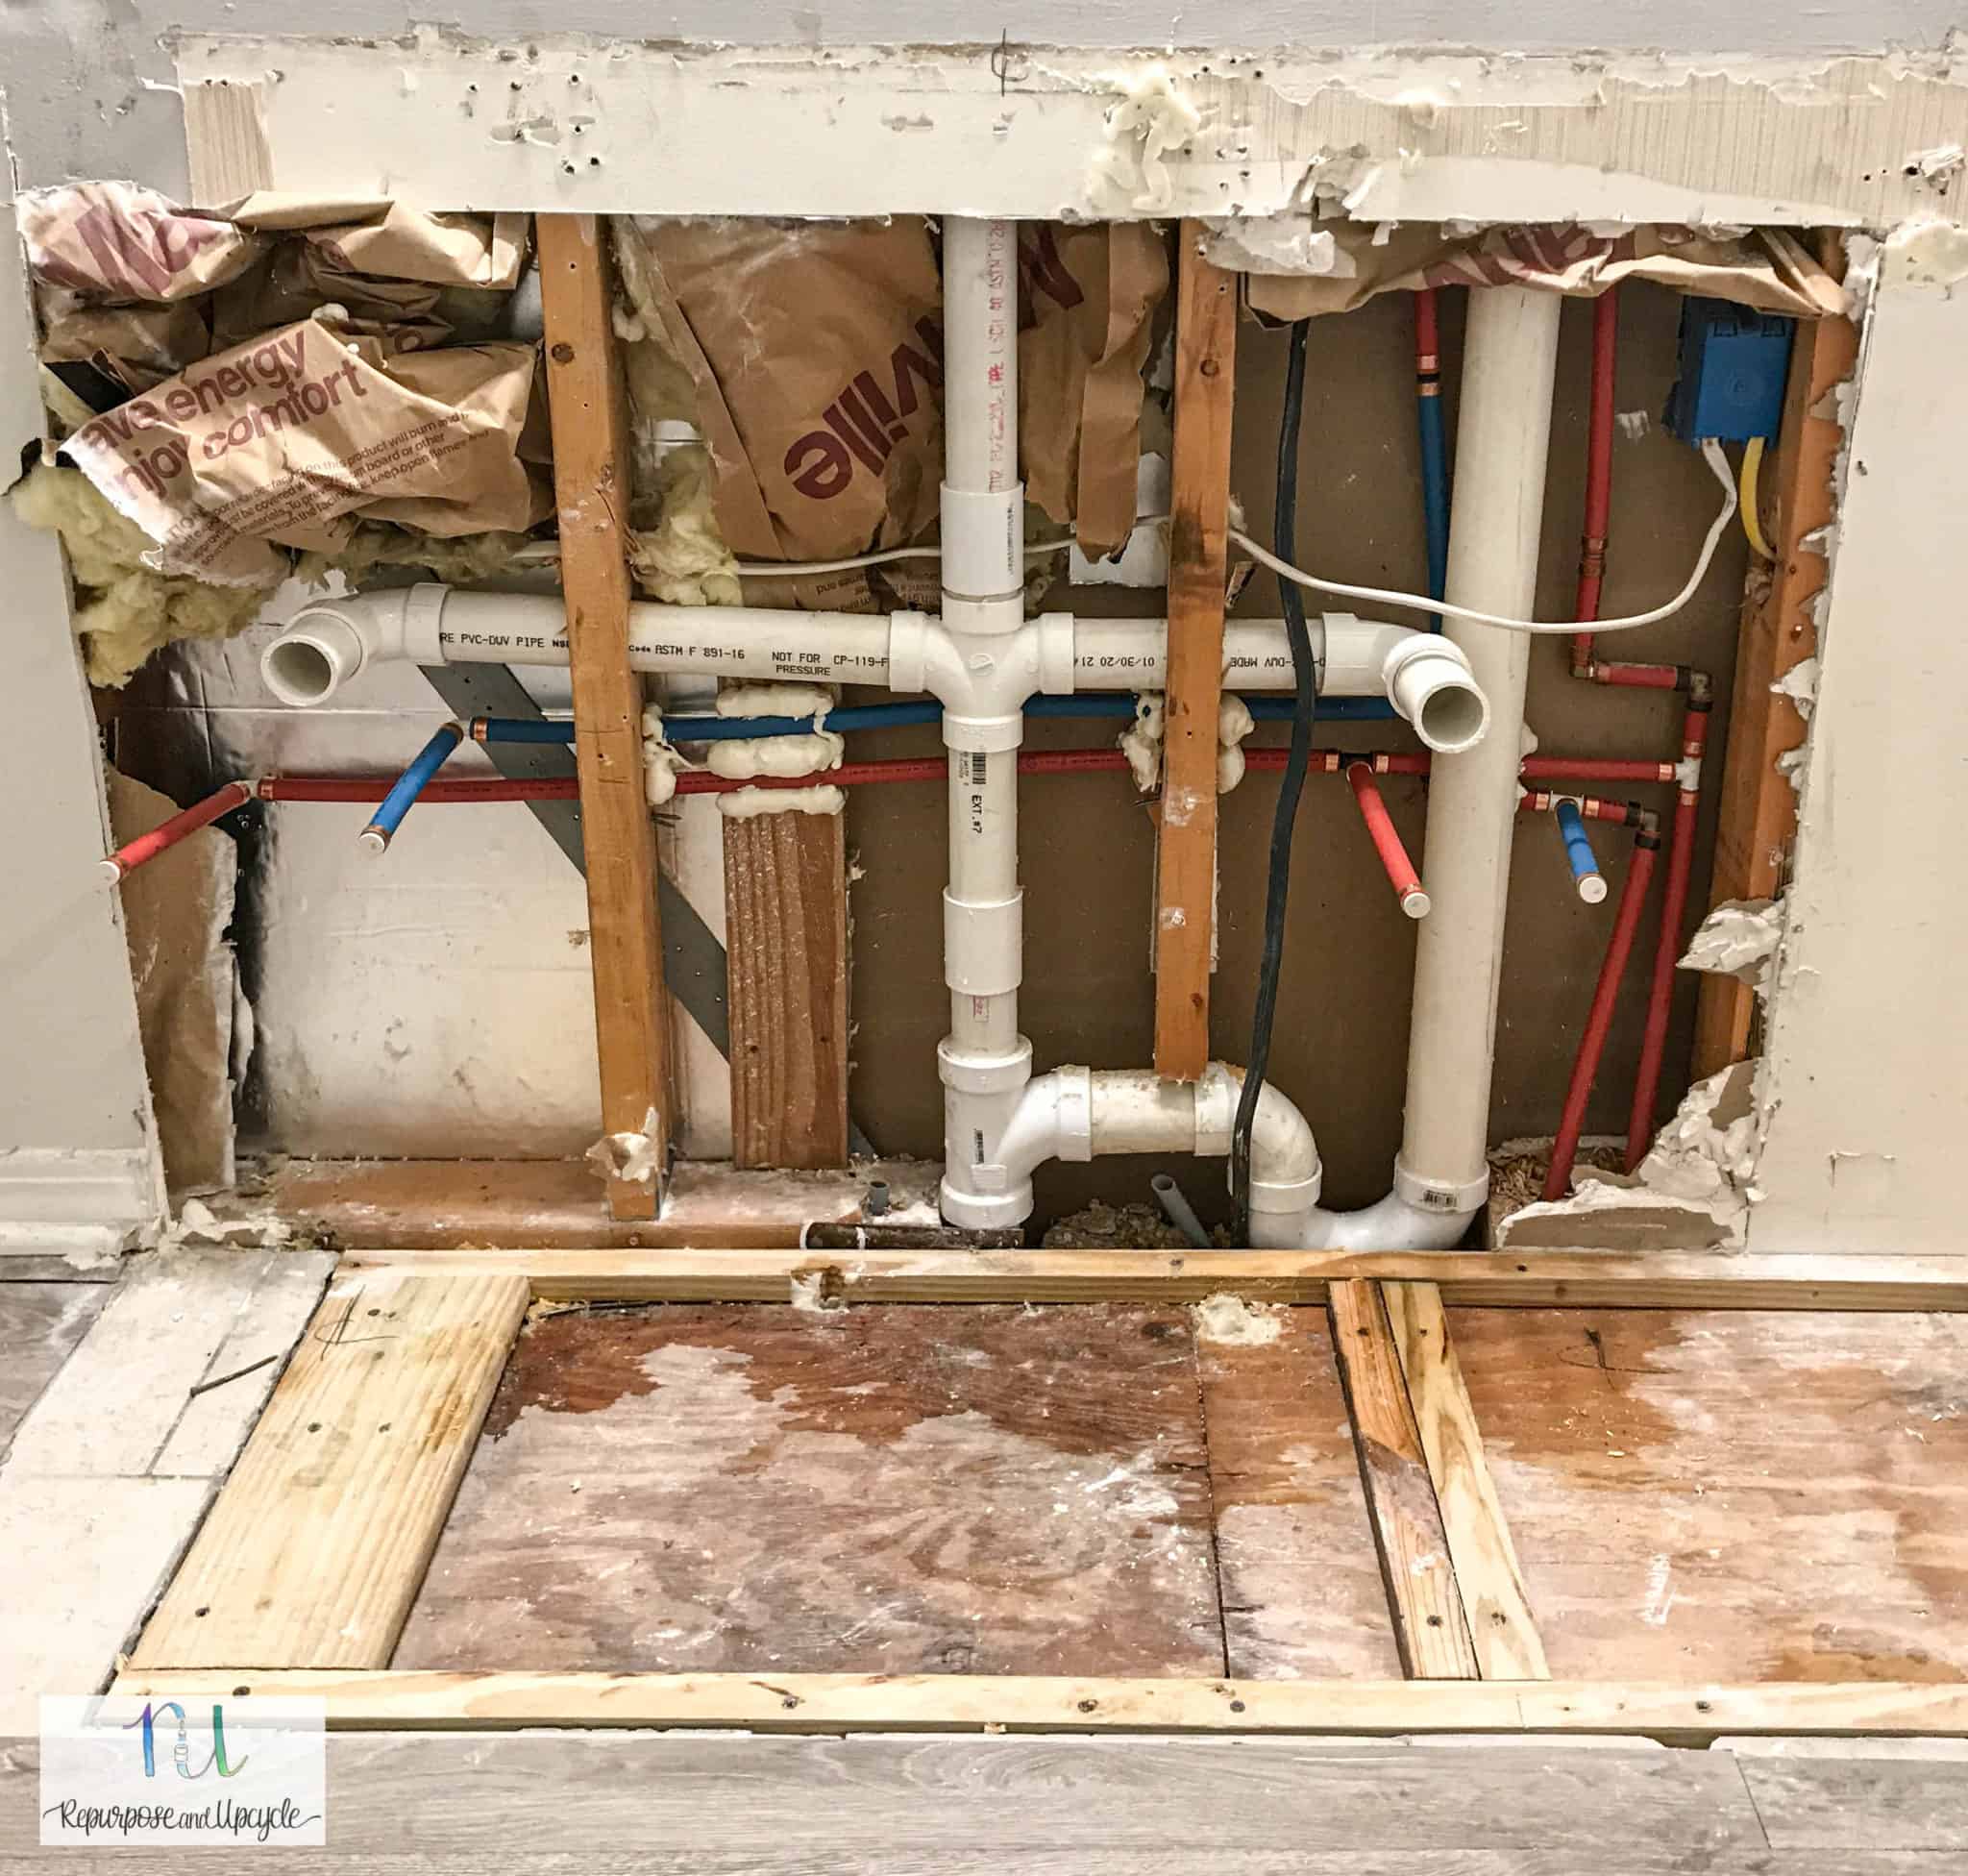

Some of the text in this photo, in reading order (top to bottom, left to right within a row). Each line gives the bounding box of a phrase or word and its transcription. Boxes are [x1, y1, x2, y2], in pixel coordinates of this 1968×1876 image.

[164, 330, 306, 421] energy
[203, 359, 368, 459] comfort
[348, 440, 387, 467] product
[389, 432, 408, 449] will
[409, 421, 436, 437] burn
[255, 488, 295, 513] covered
[367, 452, 401, 472] board
[402, 448, 414, 457] or
[415, 432, 445, 451] other
[399, 454, 430, 476] open
[516, 636, 545, 649] PIPE
[654, 645, 683, 656] ASTM
[689, 646, 697, 656] F
[702, 647, 746, 660] 891-16
[772, 652, 793, 663] NOT
[799, 653, 822, 664] FOR
[775, 664, 831, 677] PRESSURE
[1099, 656, 1155, 668] 01/30/20
[1230, 656, 1258, 668] MADE
